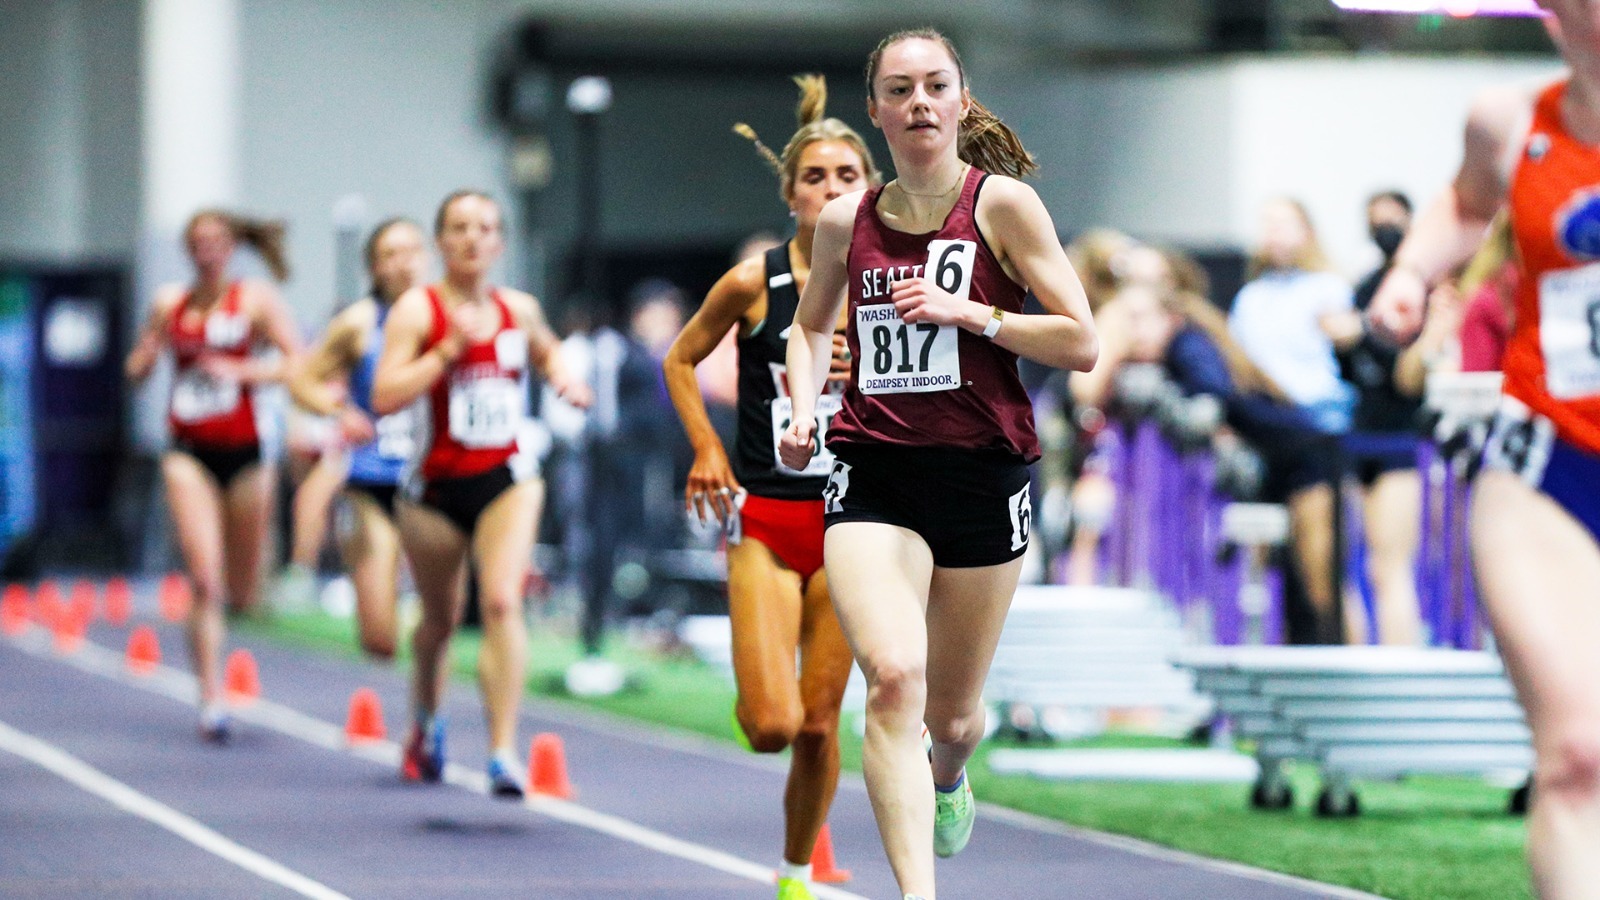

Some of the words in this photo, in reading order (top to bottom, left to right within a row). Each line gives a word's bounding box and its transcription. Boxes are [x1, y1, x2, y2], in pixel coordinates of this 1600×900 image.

[862, 264, 923, 298] SEATT
[935, 243, 965, 295] 6
[872, 324, 939, 374] 817
[866, 378, 909, 389] DEMPSEY
[912, 376, 952, 387] INDOOR
[1017, 488, 1029, 543] 6
